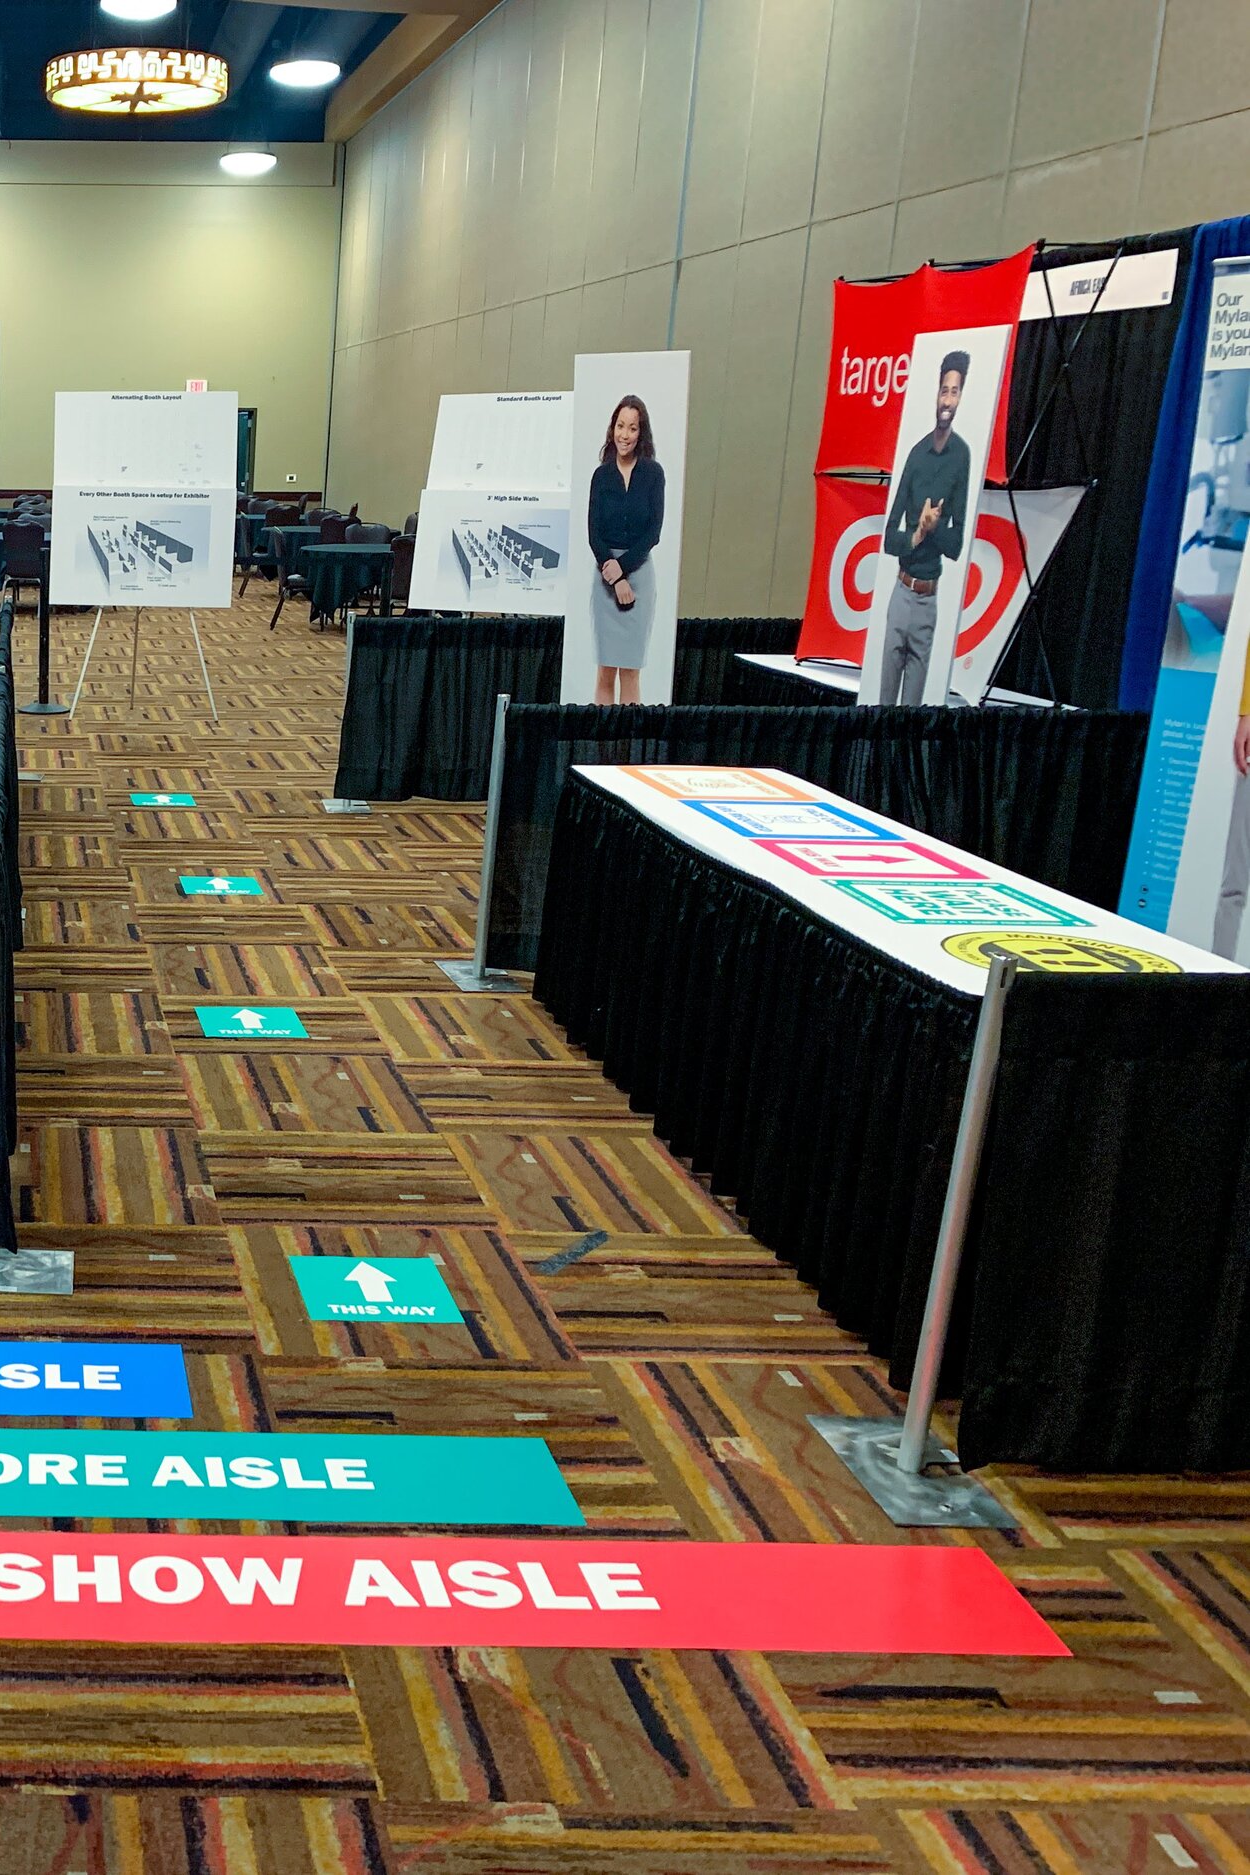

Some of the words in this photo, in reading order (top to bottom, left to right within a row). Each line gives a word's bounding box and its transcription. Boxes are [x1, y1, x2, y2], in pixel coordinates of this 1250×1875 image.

[1216, 292, 1244, 307] Our
[1214, 309, 1250, 326] Myla
[1212, 327, 1223, 341] is
[839, 345, 911, 407] targe
[878, 888, 956, 915] HERE
[920, 890, 998, 916] WAIT
[954, 889, 1032, 917] PLEASE
[327, 1304, 381, 1315] THIS
[386, 1305, 436, 1316] WAY
[151, 1455, 375, 1491] AISLE
[344, 1558, 661, 1611] AISLE
